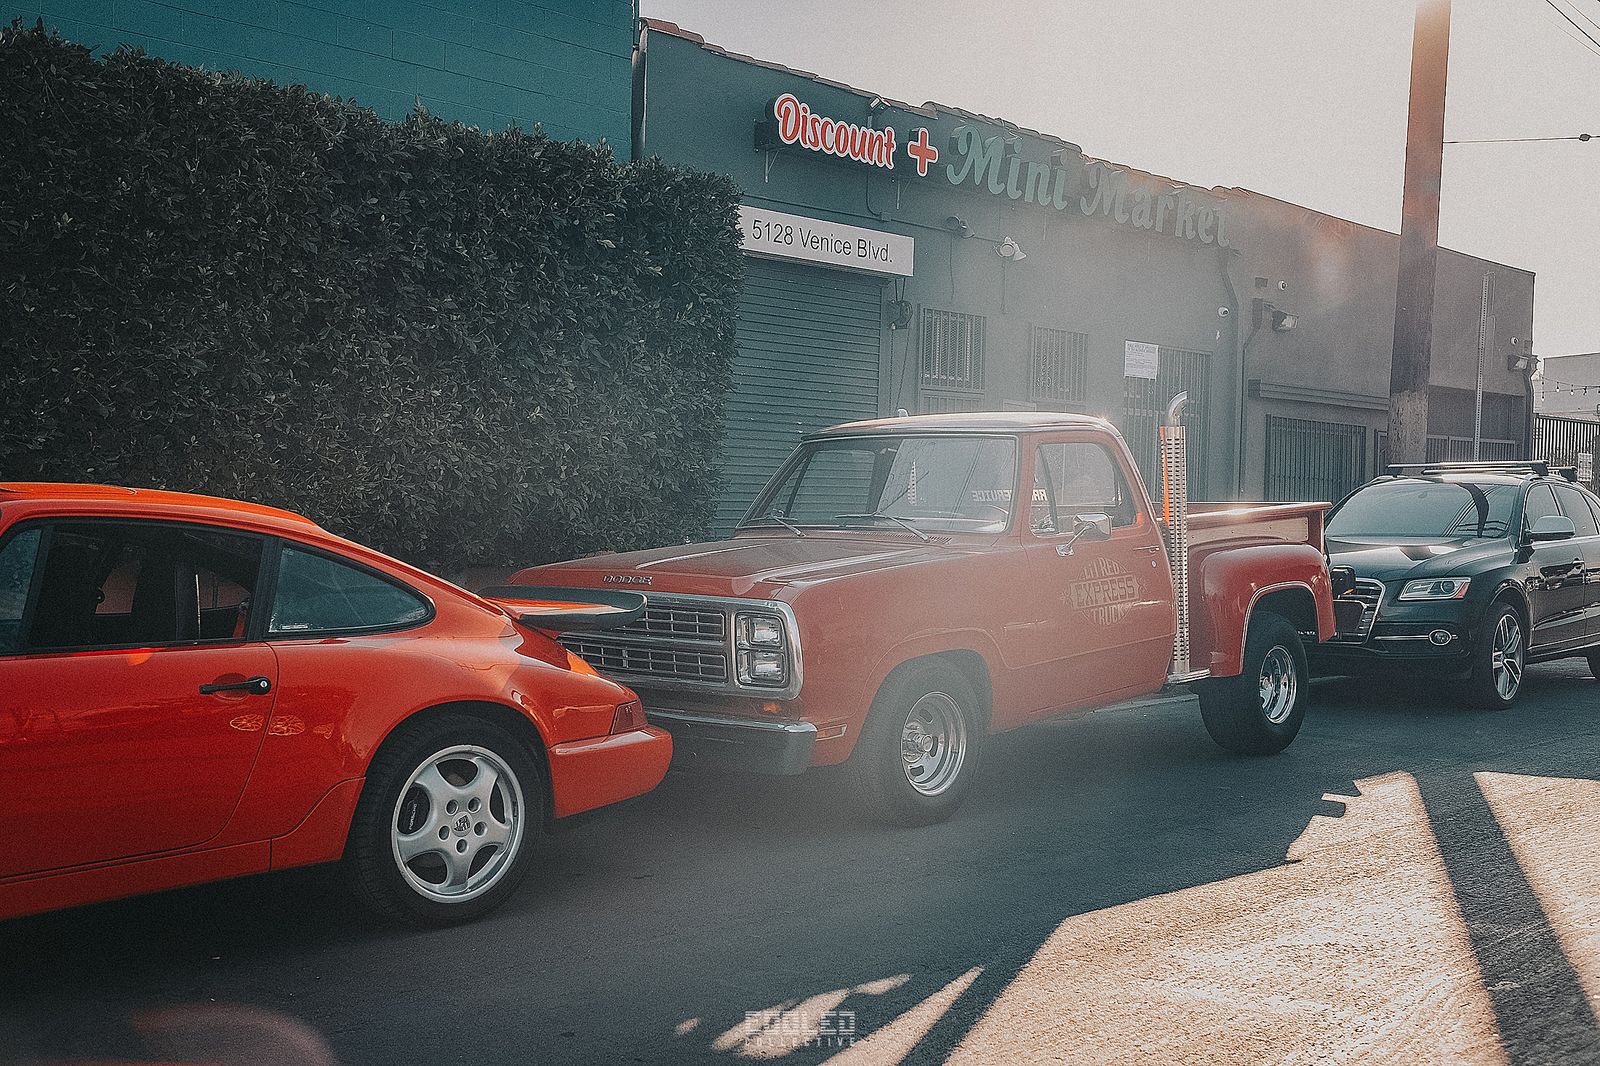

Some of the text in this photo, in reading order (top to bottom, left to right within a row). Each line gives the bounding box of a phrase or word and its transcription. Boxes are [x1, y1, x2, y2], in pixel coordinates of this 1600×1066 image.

[775, 94, 896, 169] Discount
[946, 124, 1068, 210] Mini
[1080, 163, 1230, 247] Market
[752, 219, 893, 263] 5128 Venice Blvd.
[1075, 576, 1136, 607] EXPRESS
[1091, 604, 1125, 626] TRUCK
